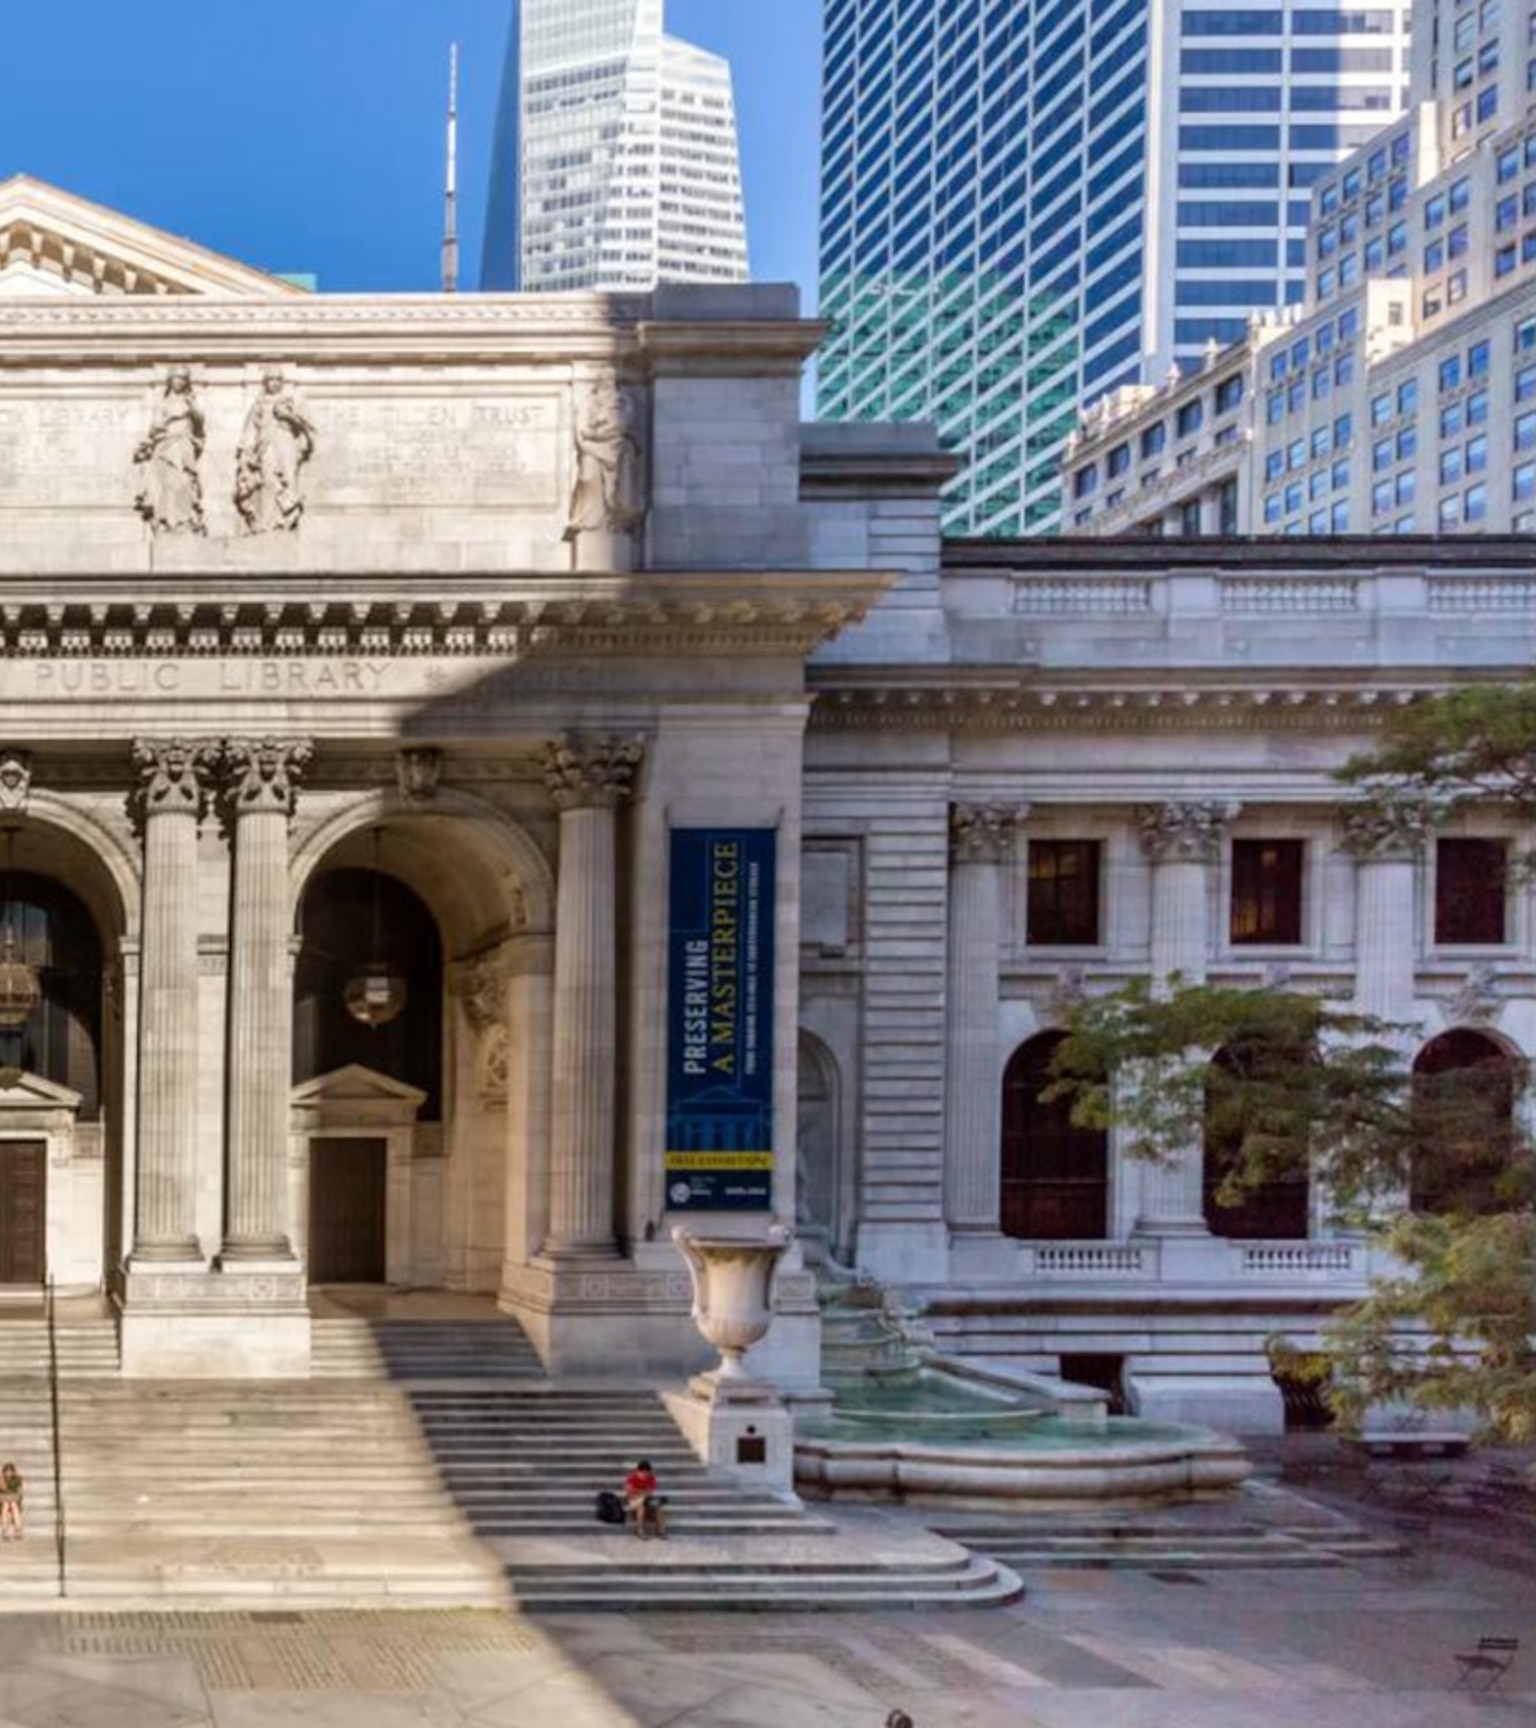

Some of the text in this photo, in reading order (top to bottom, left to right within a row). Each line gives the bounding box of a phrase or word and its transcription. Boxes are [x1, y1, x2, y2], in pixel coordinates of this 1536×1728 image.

[475, 405, 543, 426] TRUST
[34, 662, 180, 692] PUBLIC
[218, 661, 392, 692] LIBRARY
[711, 841, 739, 1075] A MASTERPIECE
[683, 939, 710, 1074] PRESERVING
